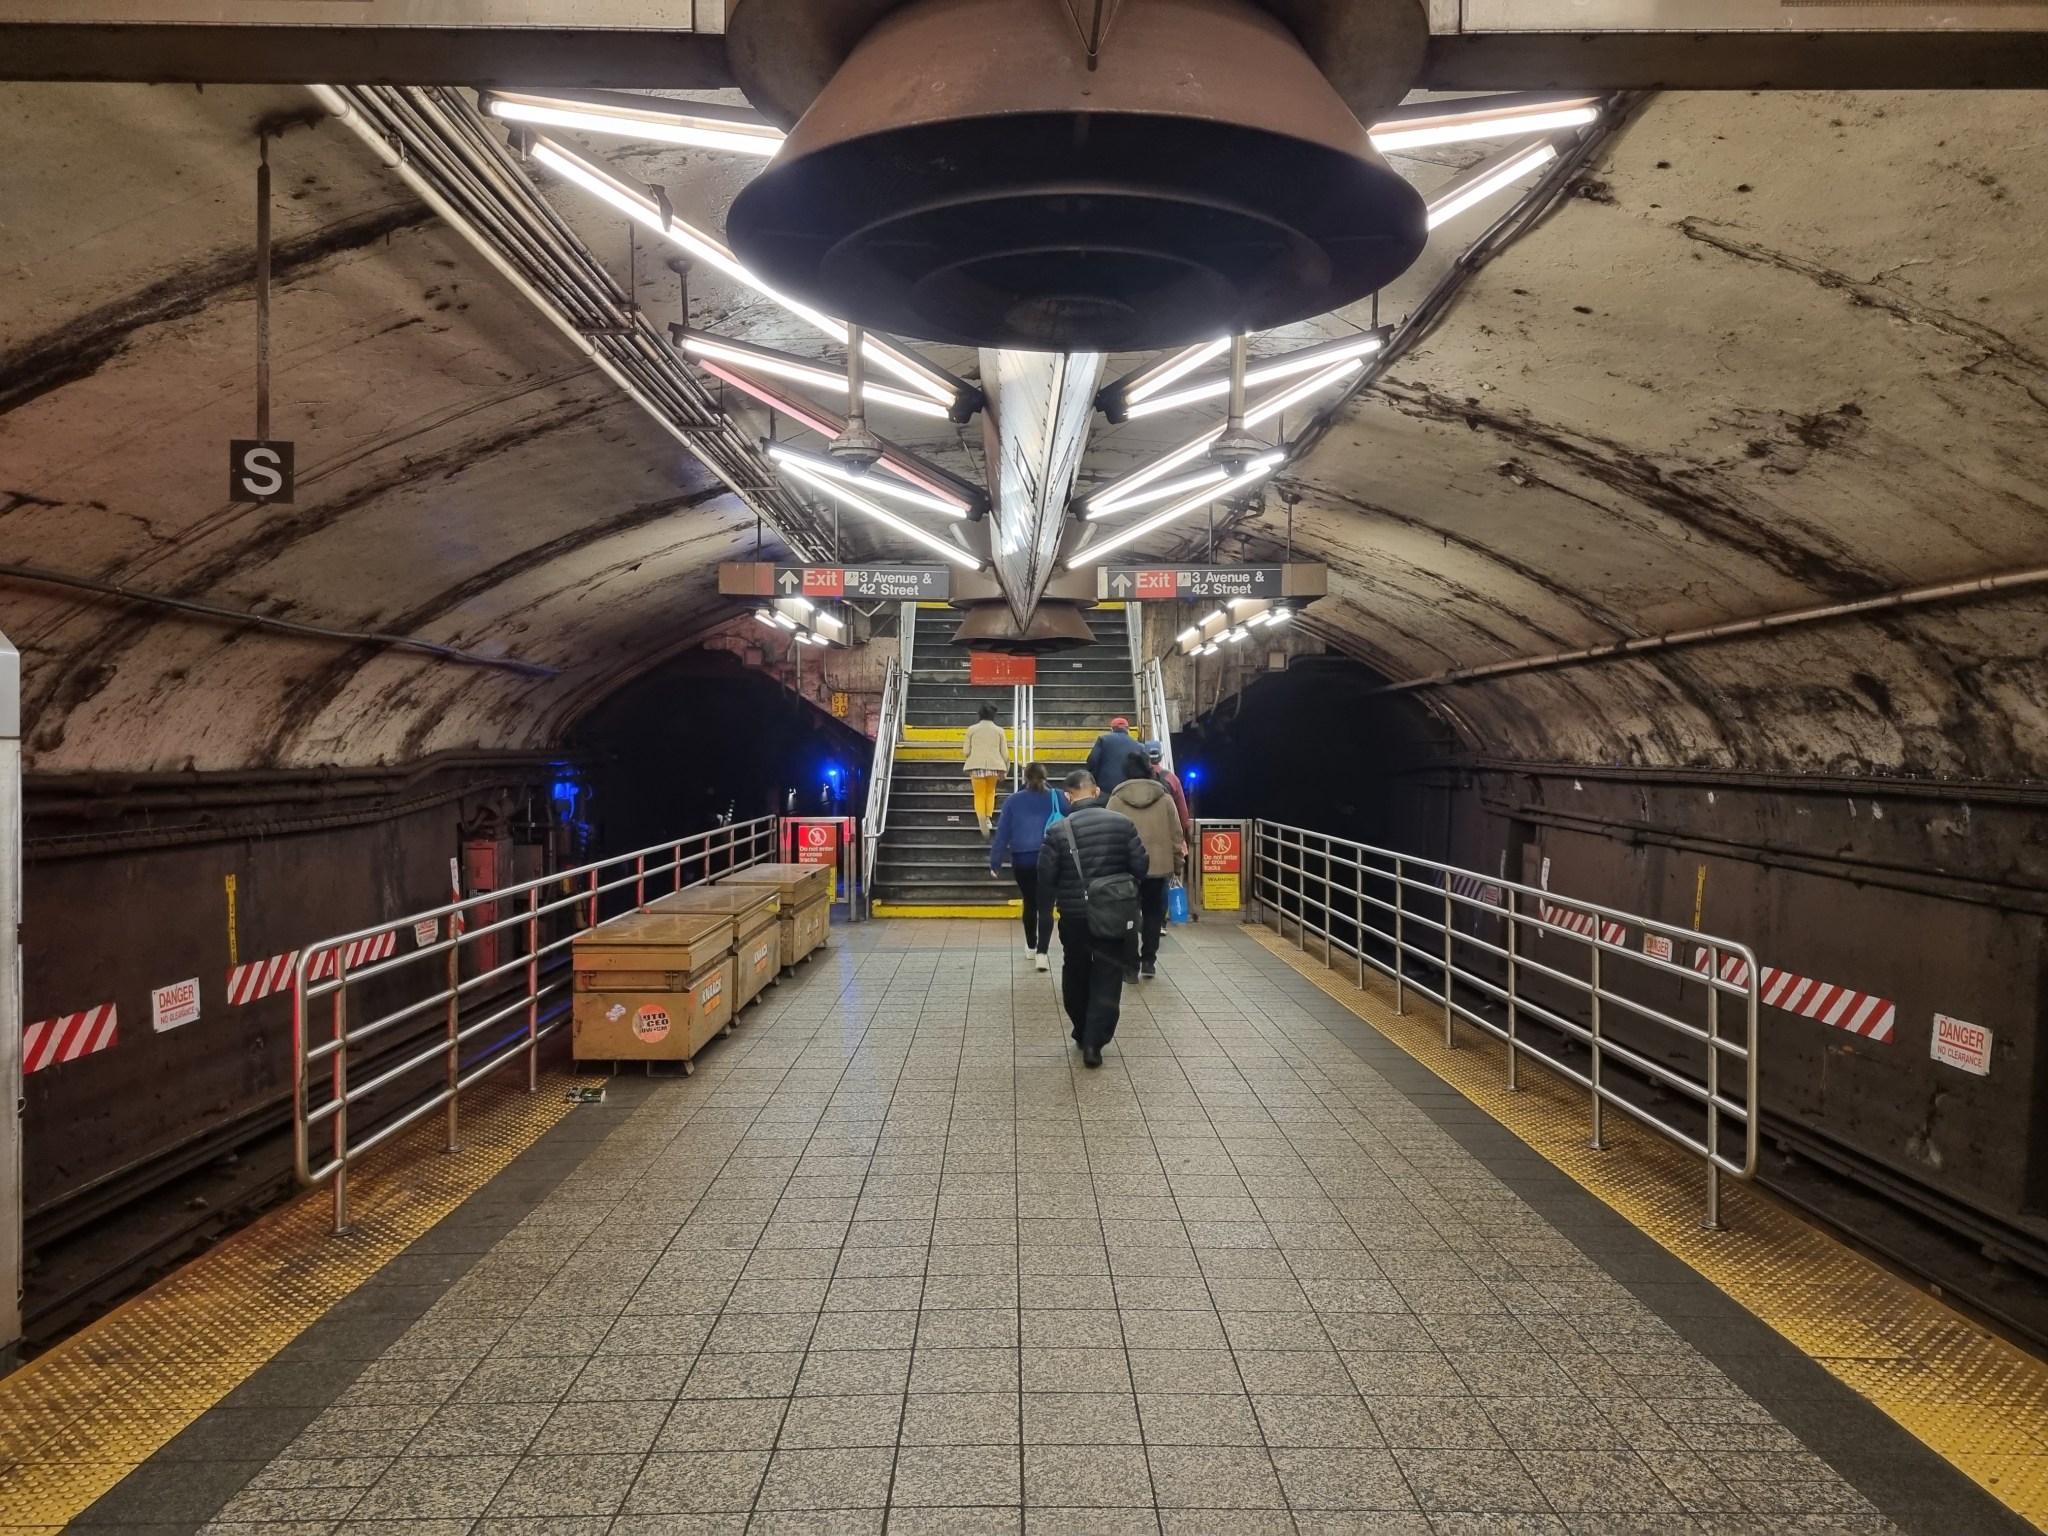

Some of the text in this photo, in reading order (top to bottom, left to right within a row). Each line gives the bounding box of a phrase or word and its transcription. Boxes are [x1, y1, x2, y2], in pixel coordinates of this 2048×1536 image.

[243, 447, 282, 496] S
[804, 571, 838, 586] Exit
[860, 572, 932, 584] 3 Avenue &
[1136, 572, 1170, 588] Exit
[1192, 571, 1264, 583] 3 Avenue &
[859, 584, 919, 595] 42 Street
[1192, 583, 1252, 594] 42 Street
[159, 984, 194, 1008] DANGER
[160, 1015, 169, 1024] NO
[1939, 1020, 1984, 1049] DANGER
[1938, 1045, 1983, 1068] NO CLEARANCE
